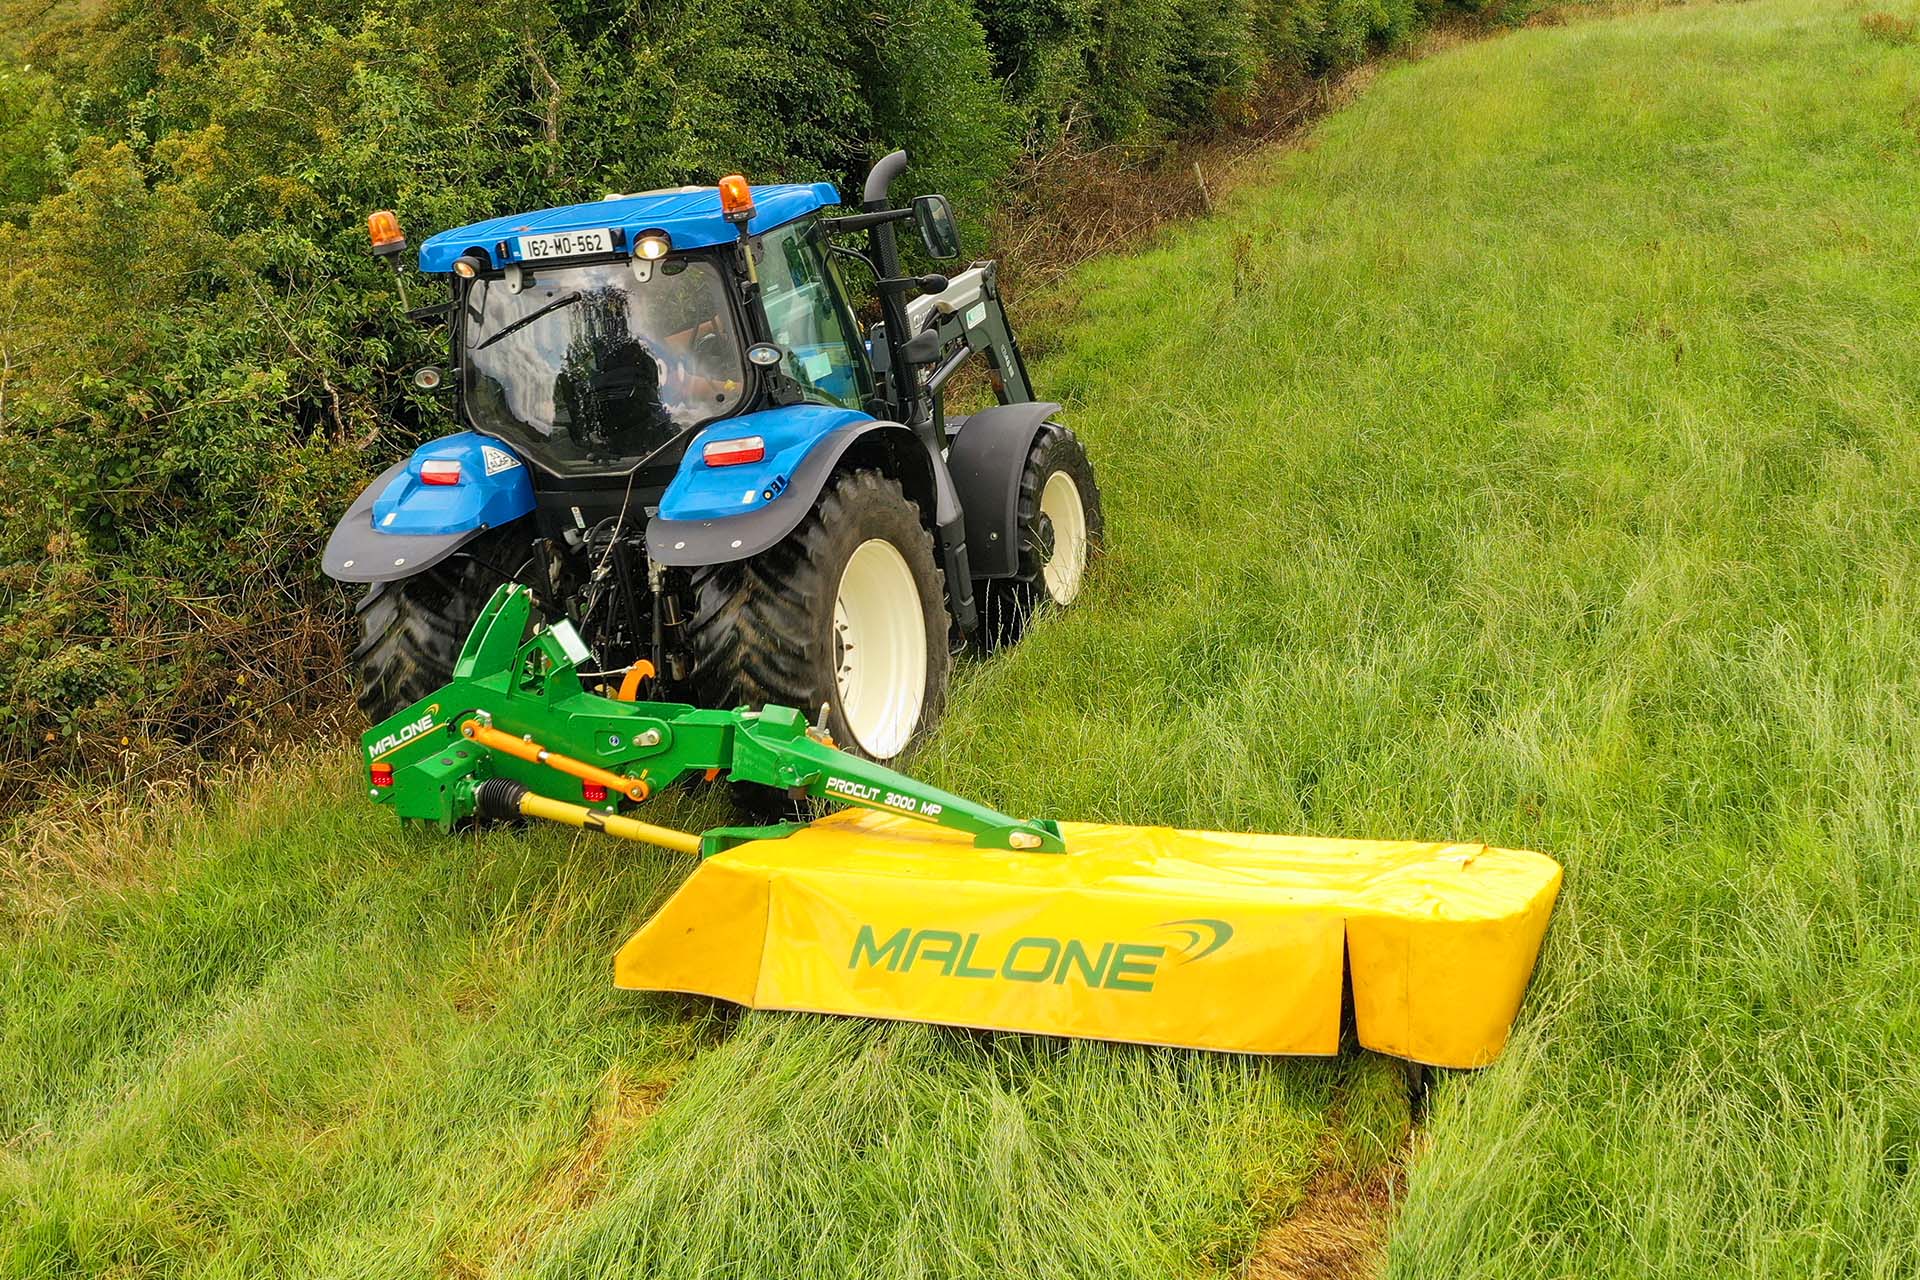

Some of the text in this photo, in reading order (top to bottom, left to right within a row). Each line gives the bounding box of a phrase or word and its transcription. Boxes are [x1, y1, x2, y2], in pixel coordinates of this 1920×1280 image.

[527, 234, 603, 257] 162-MO-562
[368, 714, 434, 758] MALONE
[825, 776, 942, 816] PROCUT 3000 MP
[848, 925, 1166, 992] MALONE
